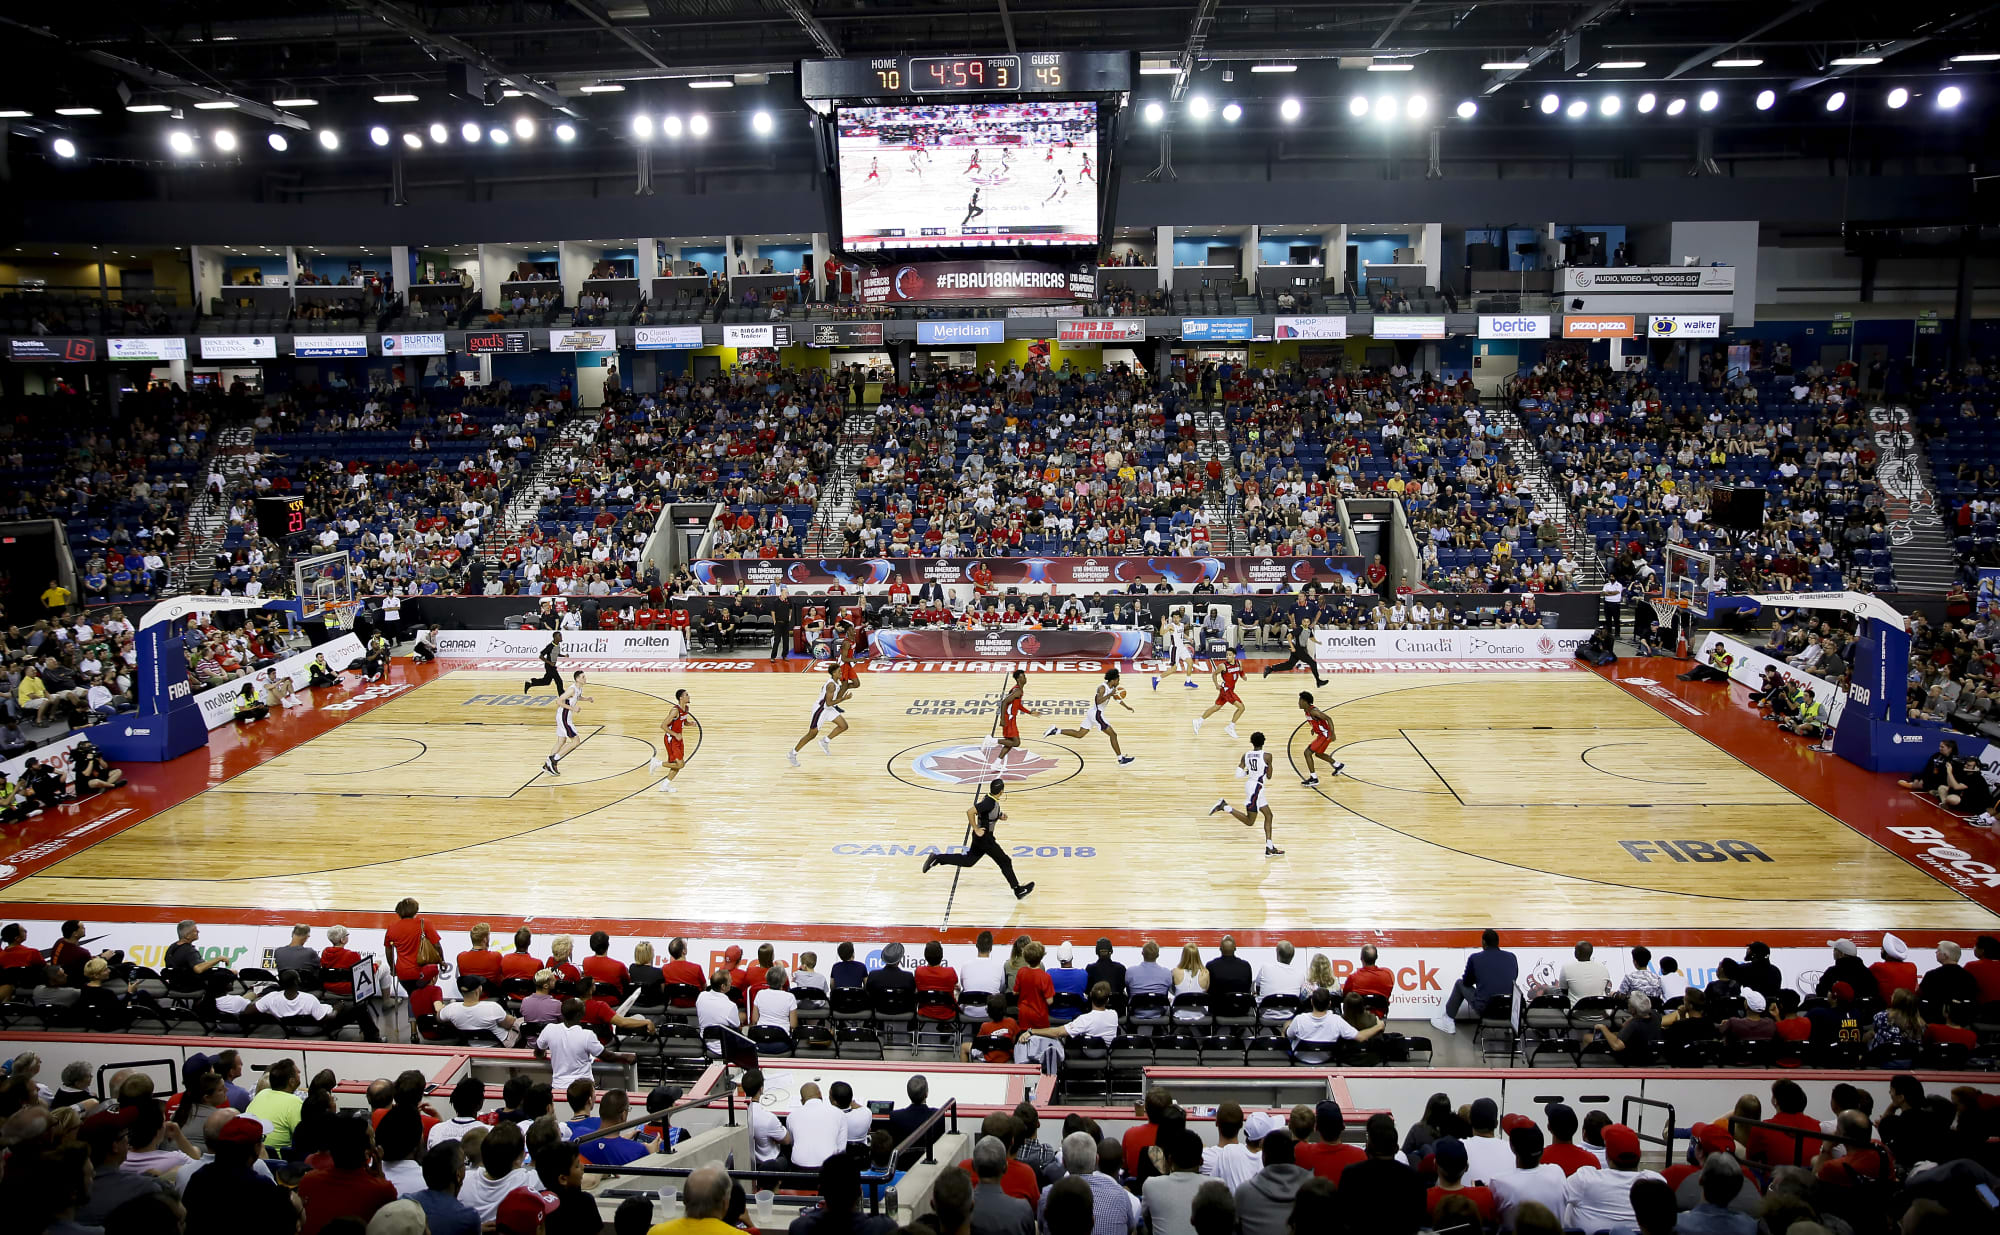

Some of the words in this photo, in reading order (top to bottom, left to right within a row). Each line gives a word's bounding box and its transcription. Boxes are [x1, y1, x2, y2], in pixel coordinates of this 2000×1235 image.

[871, 59, 896, 69] HOME
[988, 58, 1015, 68] PERIOD
[1031, 54, 1060, 65] GUEST
[930, 62, 983, 86] 4:59
[997, 67, 1008, 86] 3
[1036, 67, 1061, 86] 45
[877, 71, 899, 90] 70
[936, 272, 1065, 289] #FIBAU18AMERICAS
[1595, 275, 1619, 283] AUDIO,
[1071, 322, 1096, 330] THIS
[1099, 322, 1114, 330] IS
[1492, 318, 1536, 332] bertie
[1570, 322, 1597, 332] pizza
[1598, 322, 1626, 332] pizza
[1684, 320, 1716, 329] walker
[934, 325, 989, 337] Meridian
[1060, 331, 1084, 340] OUR
[1087, 331, 1126, 340] HOUSE
[404, 335, 442, 343] BURTNIK
[470, 334, 504, 350] gord's
[75, 344, 86, 356] B
[288, 512, 303, 532] 23
[439, 640, 476, 649] CANADA
[561, 638, 608, 653] anada
[624, 637, 669, 647] molten
[1328, 636, 1376, 647] molten
[1395, 638, 1452, 653] Canada
[337, 643, 362, 658] TOYOTA
[504, 644, 538, 654] Ontario
[1211, 644, 1227, 652] FIBA
[1488, 644, 1525, 654] Ontario
[867, 661, 1102, 672] CATHARINES
[168, 680, 191, 701] FIBA
[1849, 683, 1870, 706] FIBA
[204, 688, 237, 712] molten
[461, 694, 558, 706] FIBA
[913, 699, 951, 707] U18
[964, 699, 1091, 708] AMRICAS
[832, 844, 972, 857] CANAD
[1012, 846, 1097, 858] 2018
[1617, 839, 1775, 863] FIBA
[1916, 853, 1980, 888] University
[356, 970, 372, 991] A
